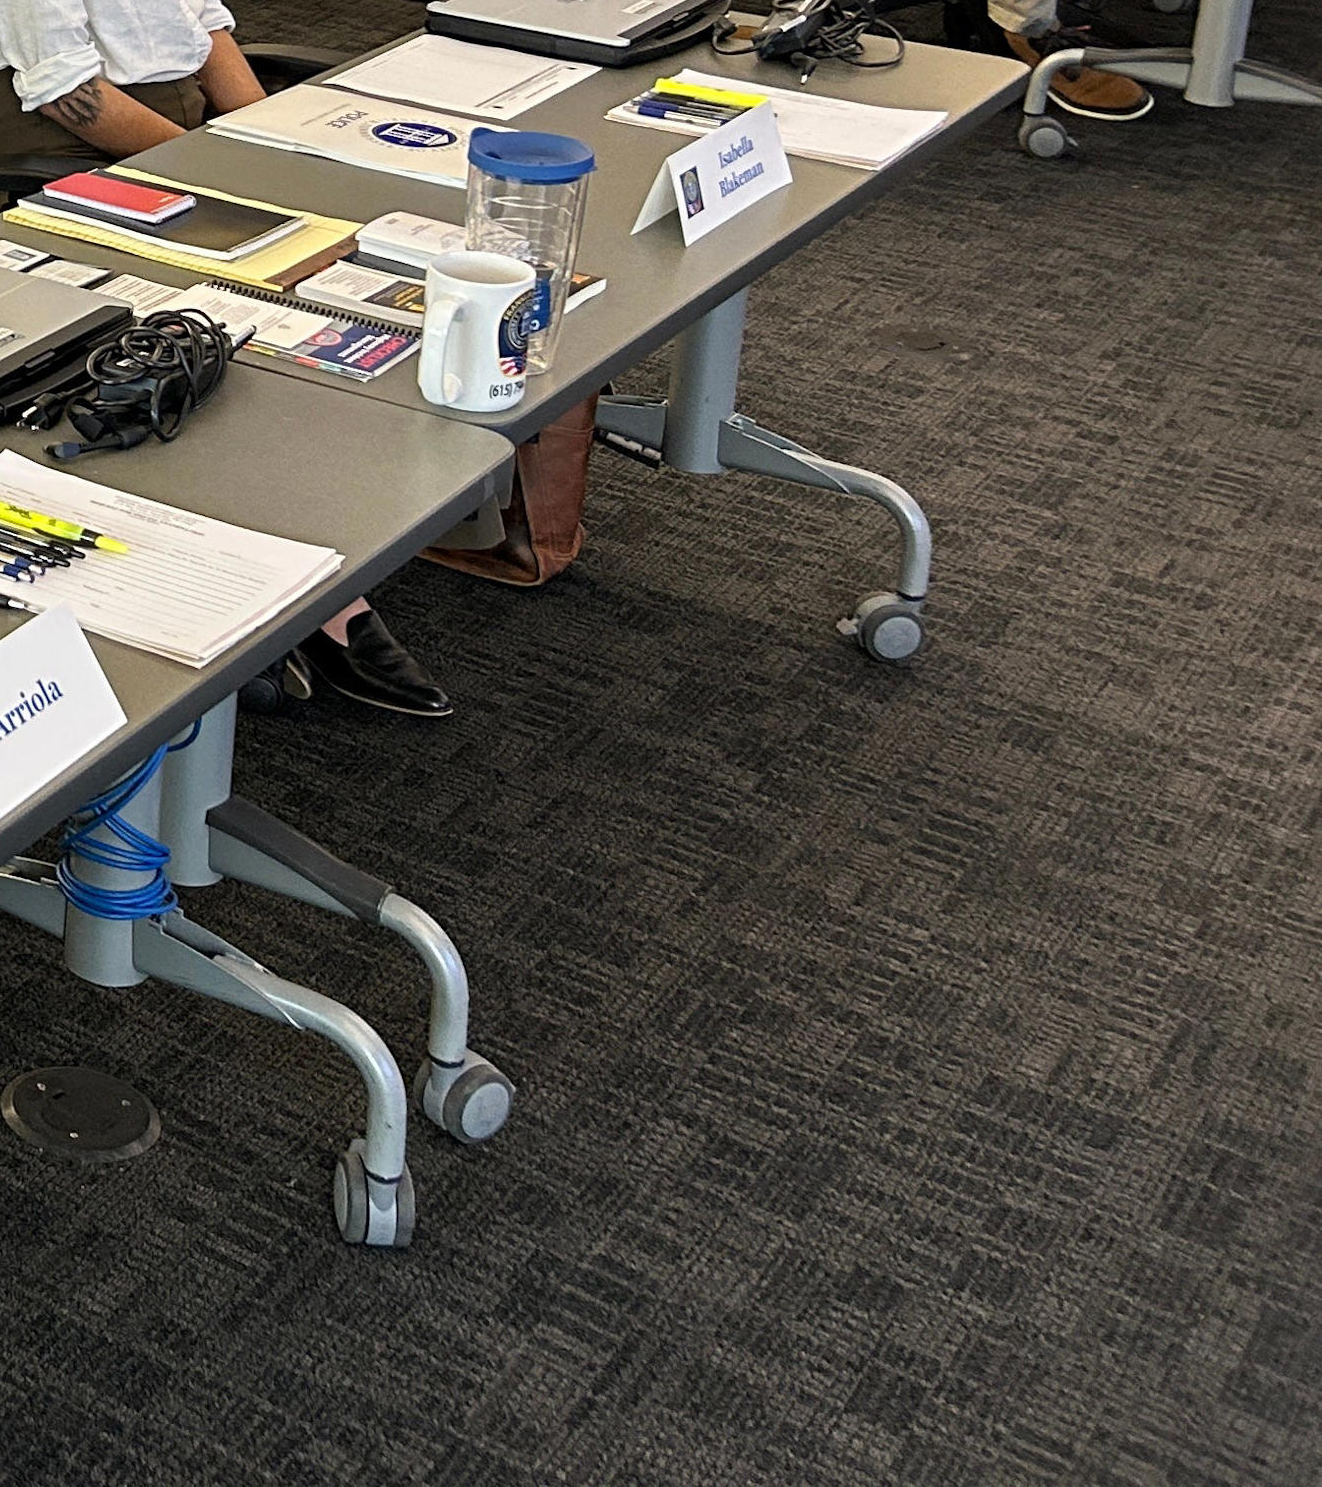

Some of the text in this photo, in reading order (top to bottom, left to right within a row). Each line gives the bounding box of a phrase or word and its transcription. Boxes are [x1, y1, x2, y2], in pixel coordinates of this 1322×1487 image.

[718, 135, 754, 169] Isabella
[718, 162, 765, 198] Blakeman
[489, 382, 513, 399] (615)
